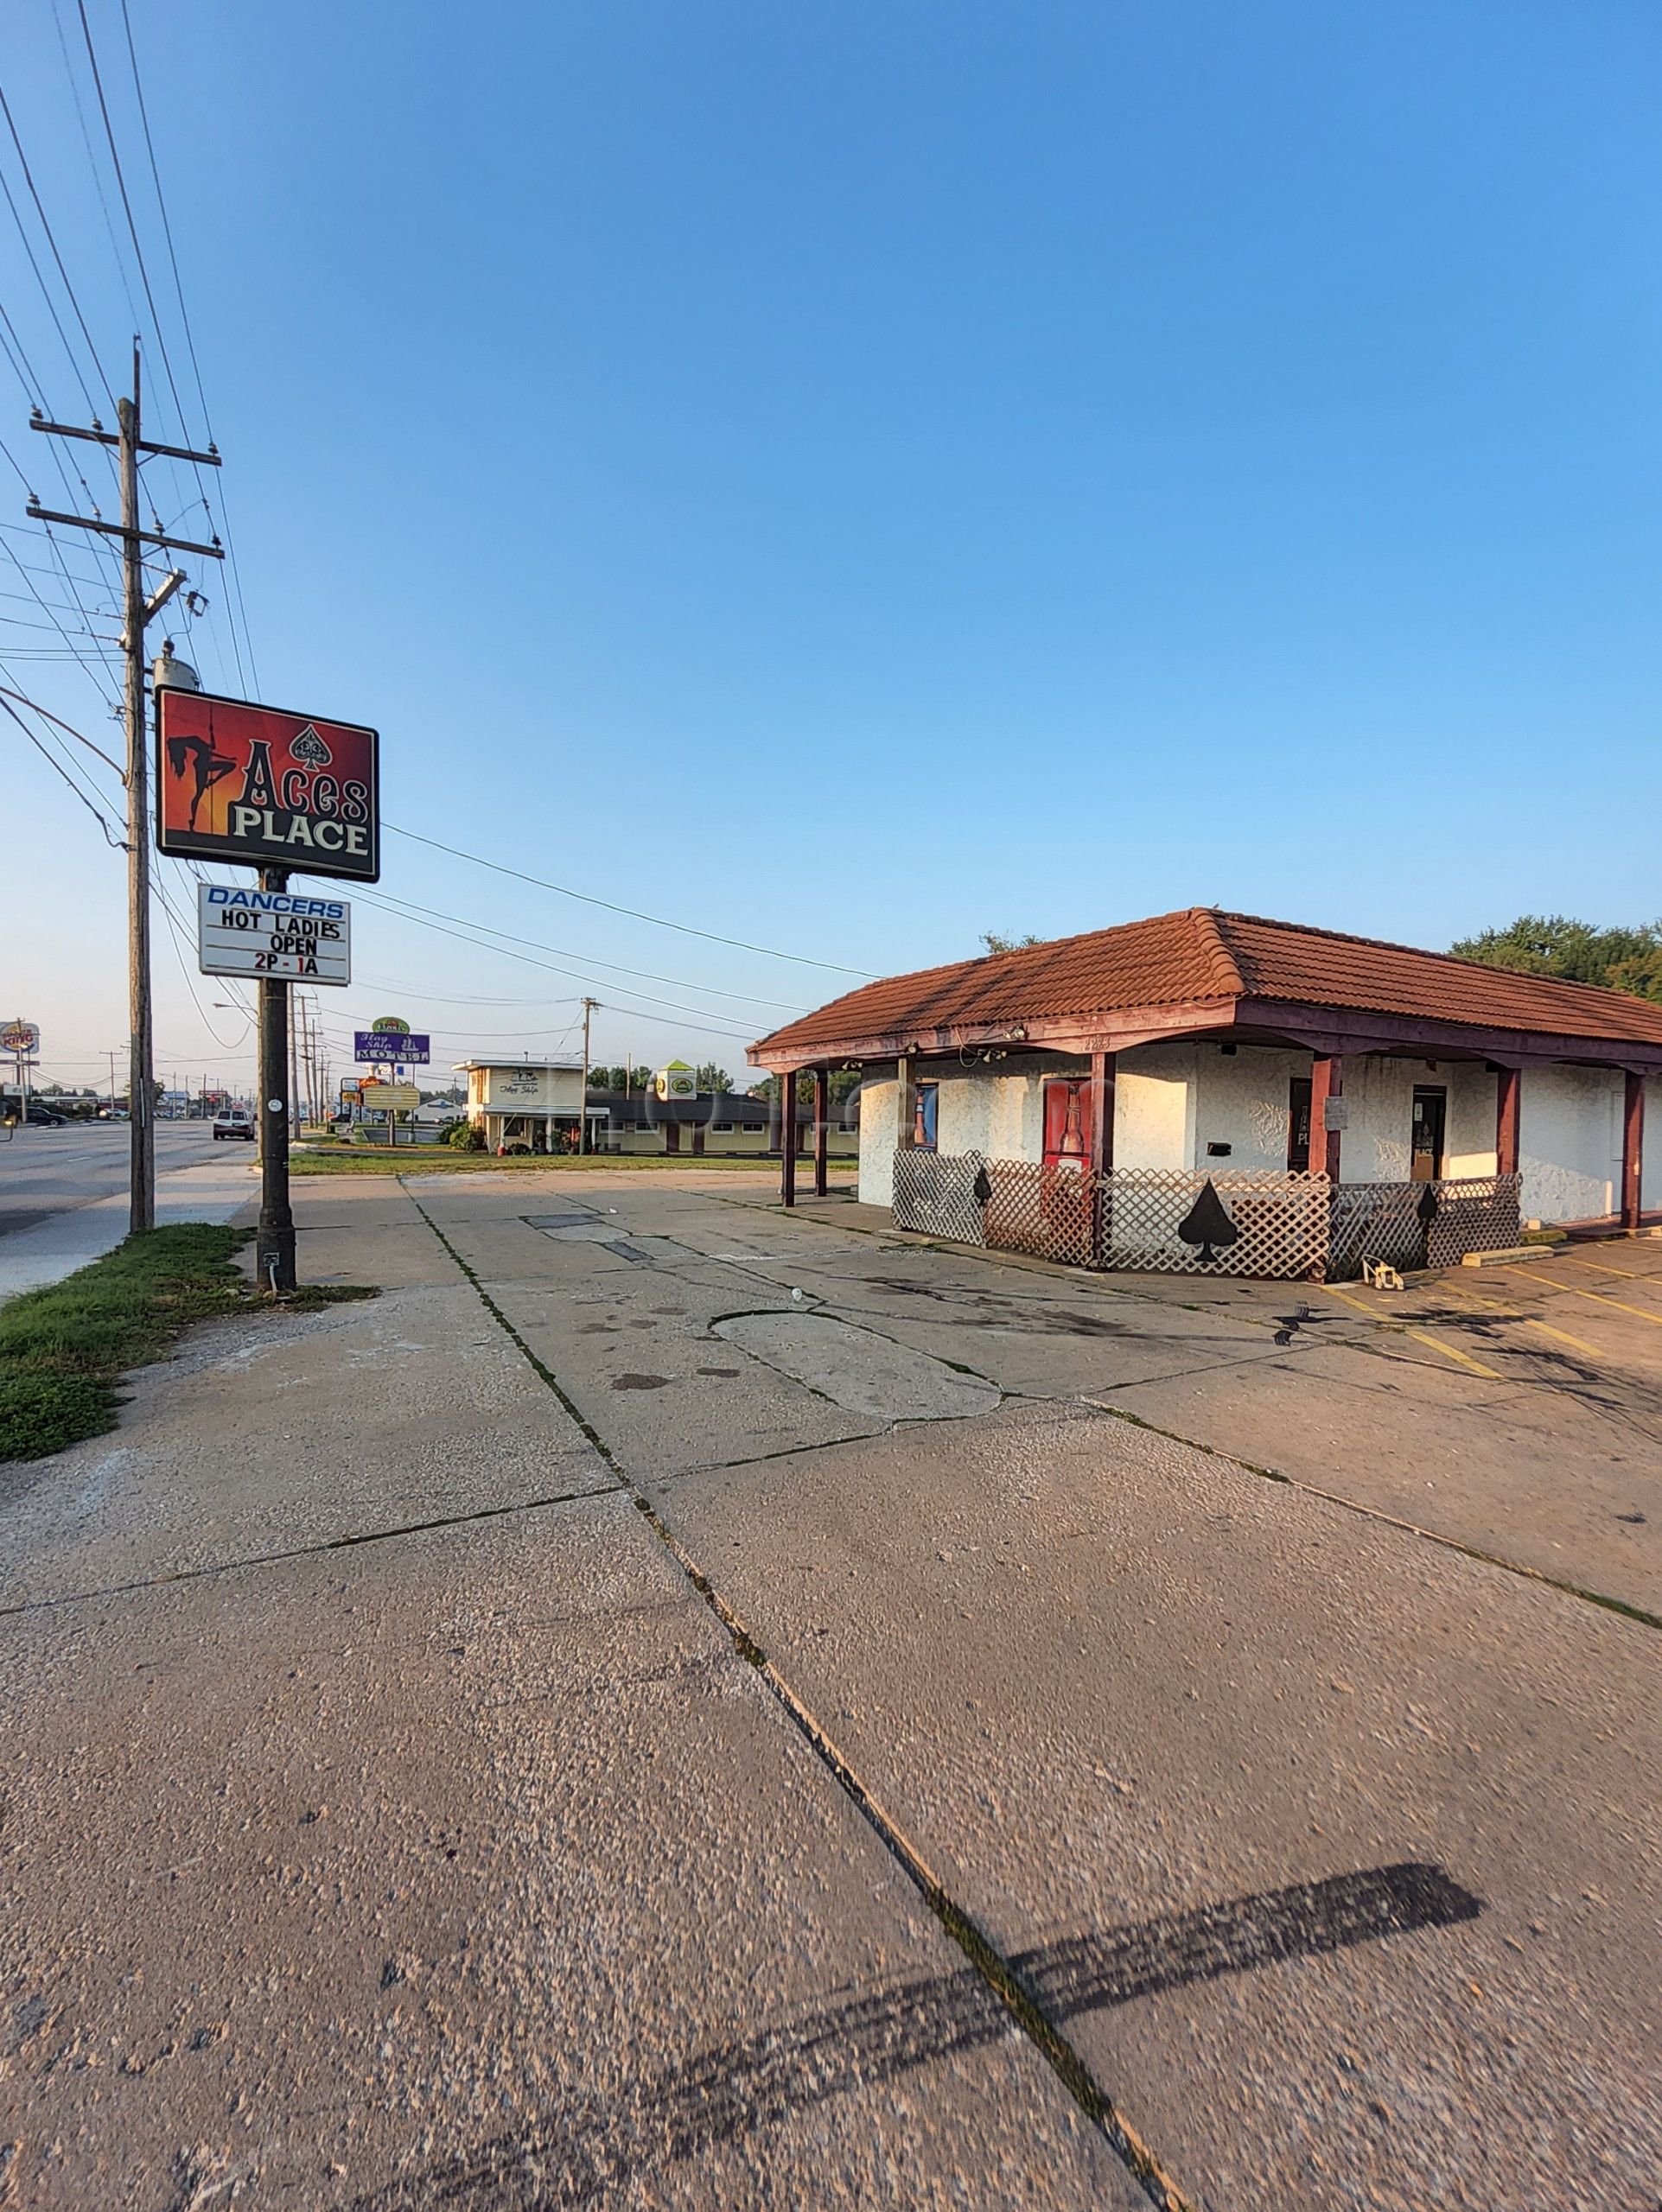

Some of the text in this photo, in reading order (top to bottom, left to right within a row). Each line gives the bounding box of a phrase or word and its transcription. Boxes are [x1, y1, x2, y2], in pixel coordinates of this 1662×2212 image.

[232, 805, 369, 856] PLACE
[207, 887, 344, 918] DANCERS
[221, 909, 341, 939] HOT LADIES
[271, 934, 317, 957] OPEN
[255, 952, 277, 970] 2P
[298, 954, 319, 975] 1A
[360, 1050, 425, 1061] MOTEL
[365, 1040, 392, 1052] Ship
